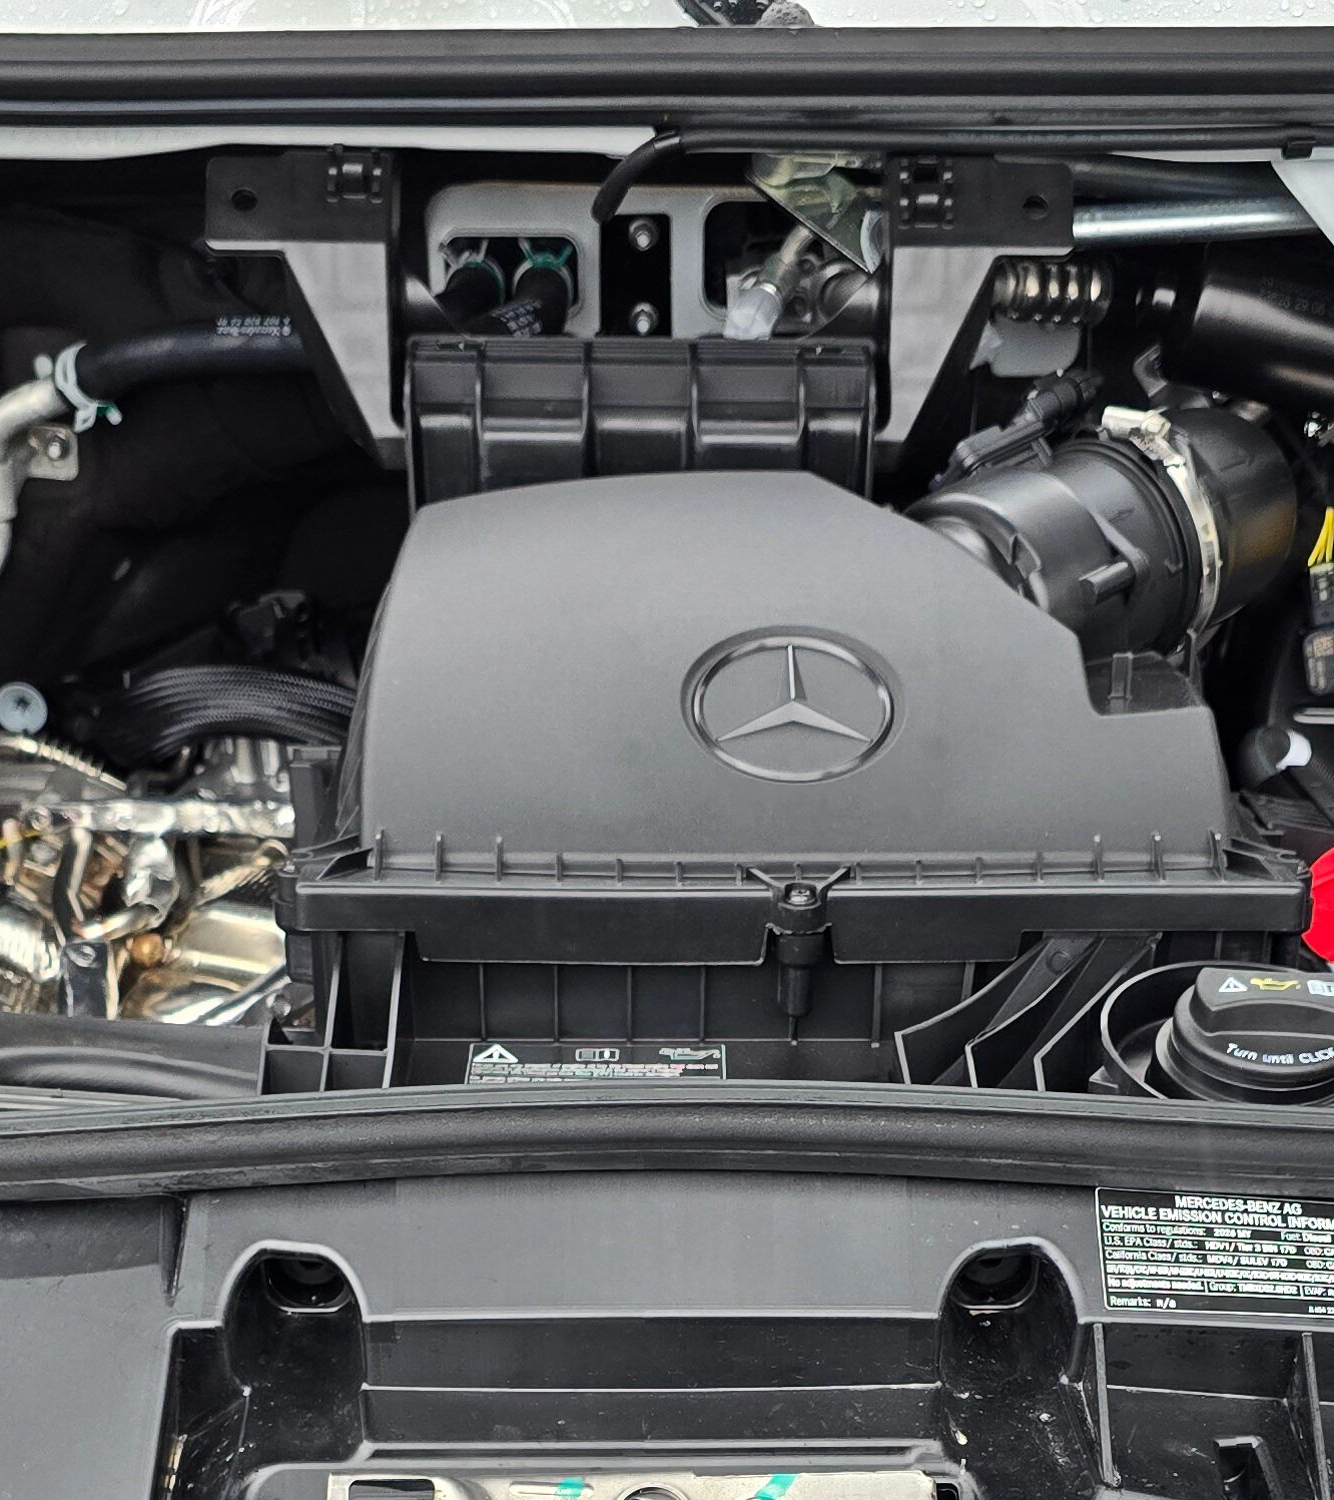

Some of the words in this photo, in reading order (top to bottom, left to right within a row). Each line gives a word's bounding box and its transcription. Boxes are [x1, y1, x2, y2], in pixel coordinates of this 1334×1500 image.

[1227, 1043, 1257, 1060] Turn
[1263, 1054, 1294, 1065] until
[1175, 1196, 1282, 1214] MERCEDES-BENZ
[1283, 1202, 1302, 1215] AG
[1101, 1205, 1156, 1220] VEHICLE
[1159, 1208, 1222, 1224] EMISSION
[1224, 1212, 1286, 1228] CONTROL
[1102, 1222, 1144, 1233] Conforms
[1146, 1224, 1155, 1233] to
[1157, 1225, 1206, 1237] regulations:
[1104, 1236, 1122, 1246] U.S.
[1124, 1238, 1142, 1247] EPA
[1106, 1250, 1147, 1260] California
[1209, 1282, 1236, 1293] Group:
[1110, 1296, 1151, 1308] Remarks:
[1156, 1298, 1176, 1309] n/a
